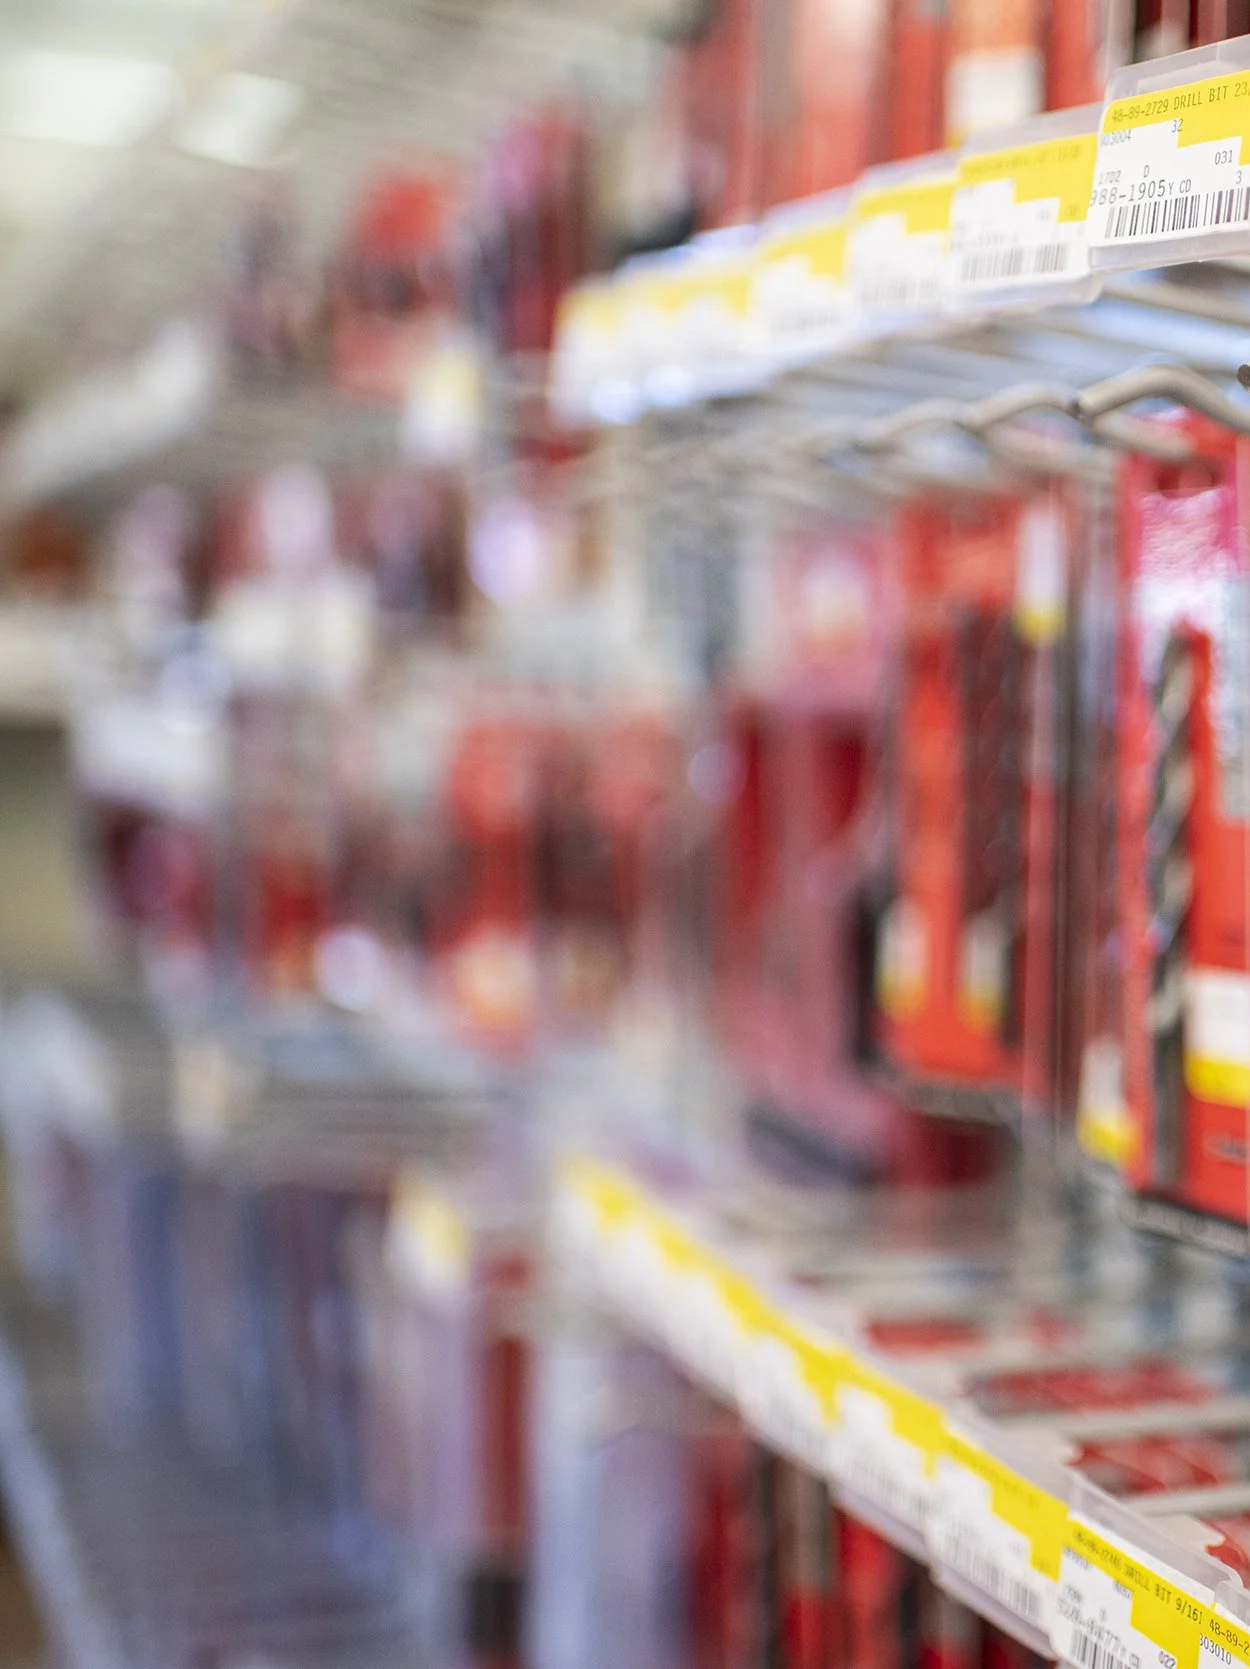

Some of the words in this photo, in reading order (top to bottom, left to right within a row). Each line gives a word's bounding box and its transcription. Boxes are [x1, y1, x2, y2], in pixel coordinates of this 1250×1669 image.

[1112, 98, 1170, 122] 48-89-2729
[1173, 90, 1203, 109] DRILL
[1208, 84, 1229, 102] BIT
[1171, 117, 1184, 133] 32
[1214, 149, 1233, 165] 031
[1143, 164, 1150, 178] D
[1179, 178, 1192, 194] CD
[1152, 1582, 1172, 1605] BIT
